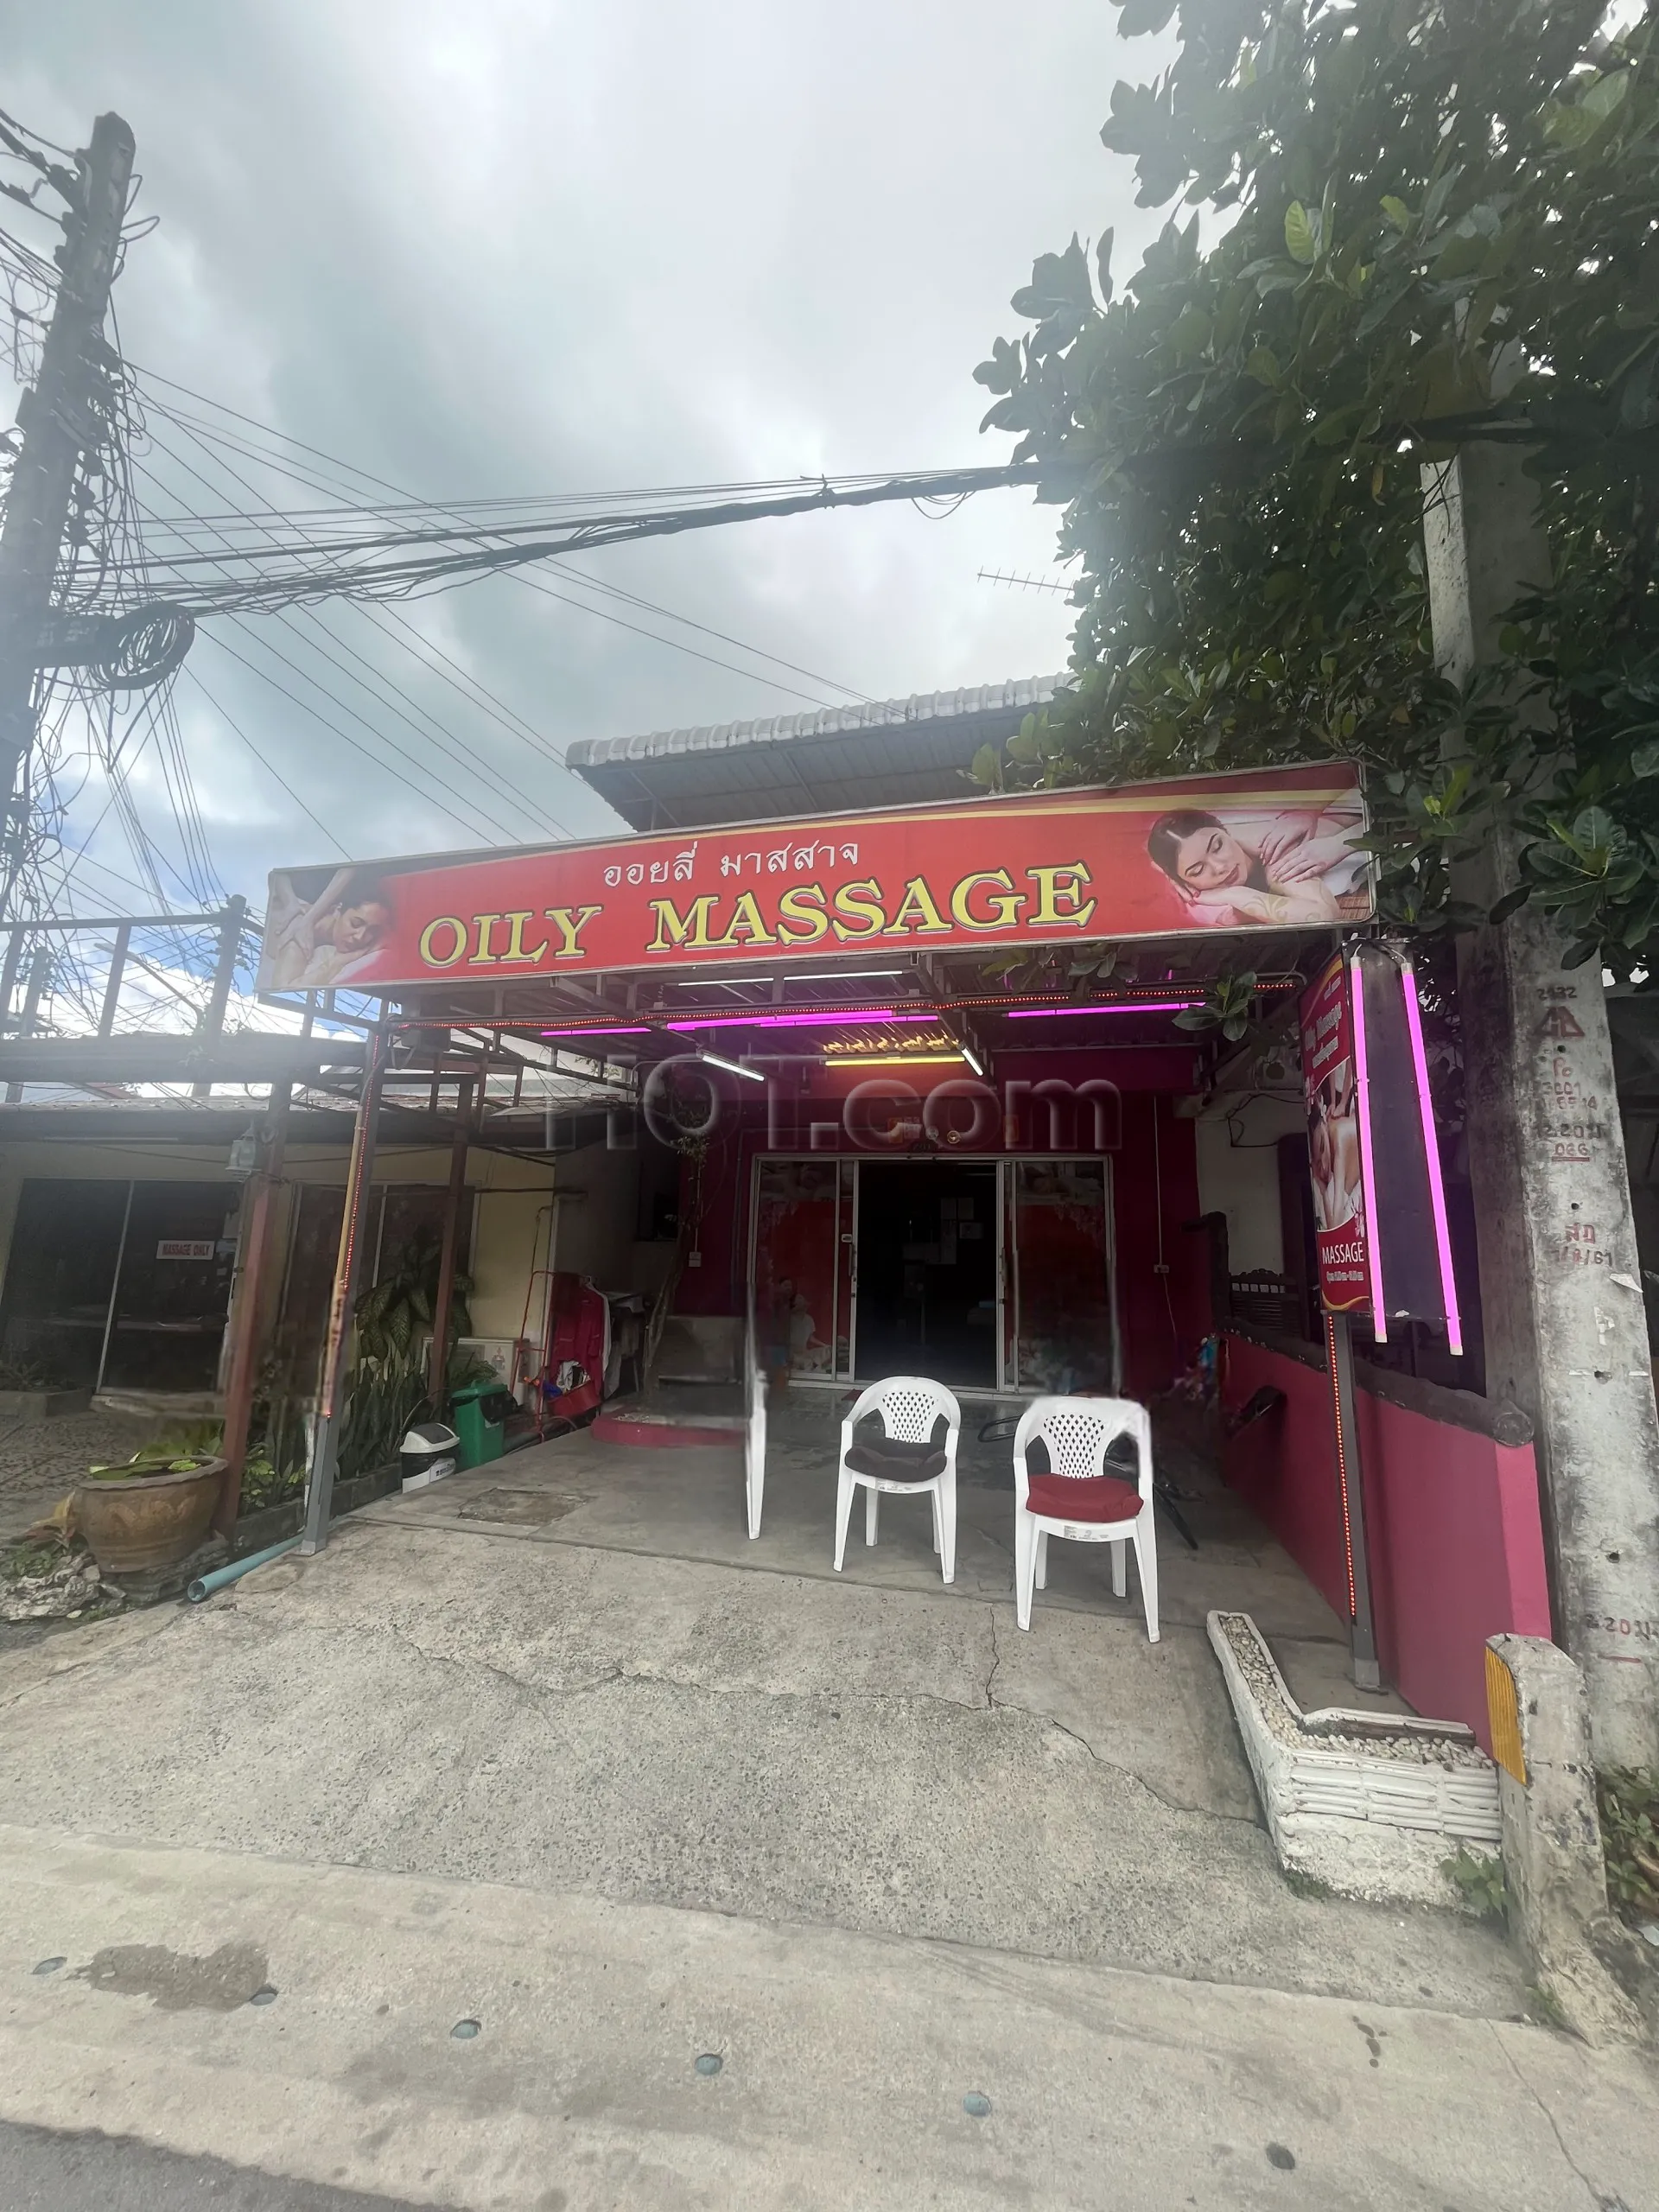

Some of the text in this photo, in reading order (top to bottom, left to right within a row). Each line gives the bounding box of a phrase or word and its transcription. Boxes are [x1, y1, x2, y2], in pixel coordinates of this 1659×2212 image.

[604, 840, 858, 887] ออยลี่ มาสสาจ
[419, 861, 1097, 968] OILY MASSAGE
[1322, 1242, 1364, 1264] MASSAGE
